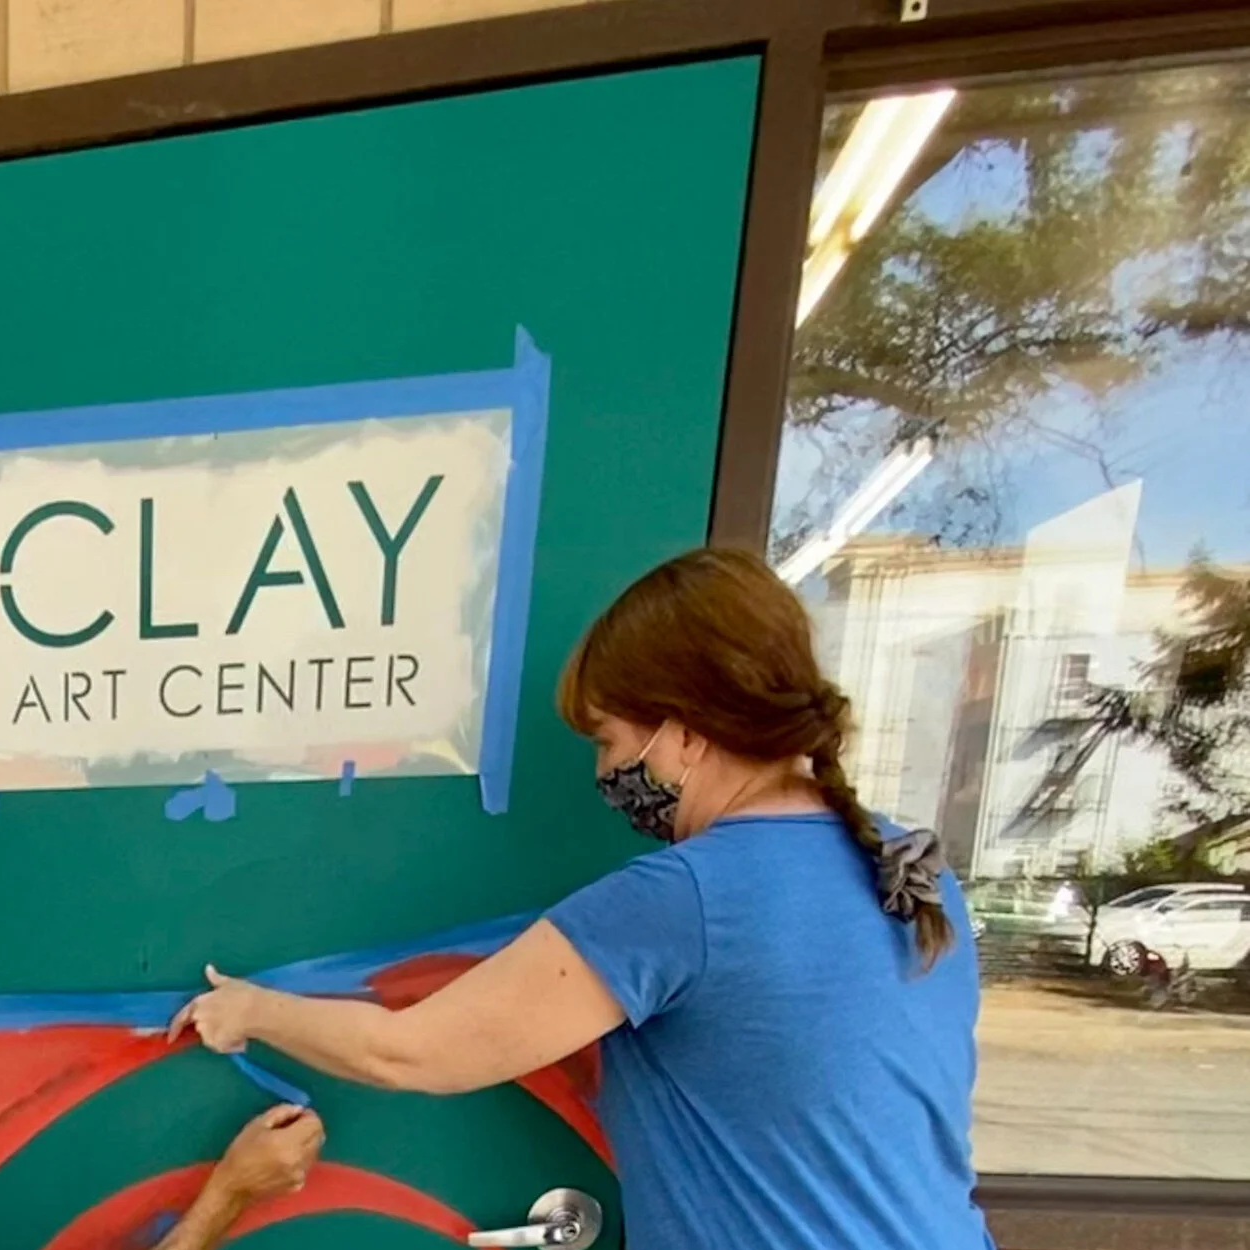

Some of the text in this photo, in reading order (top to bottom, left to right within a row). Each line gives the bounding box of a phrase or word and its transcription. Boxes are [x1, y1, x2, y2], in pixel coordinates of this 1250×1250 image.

[0, 475, 445, 648] CLAY
[12, 654, 420, 725] ART CENTER
